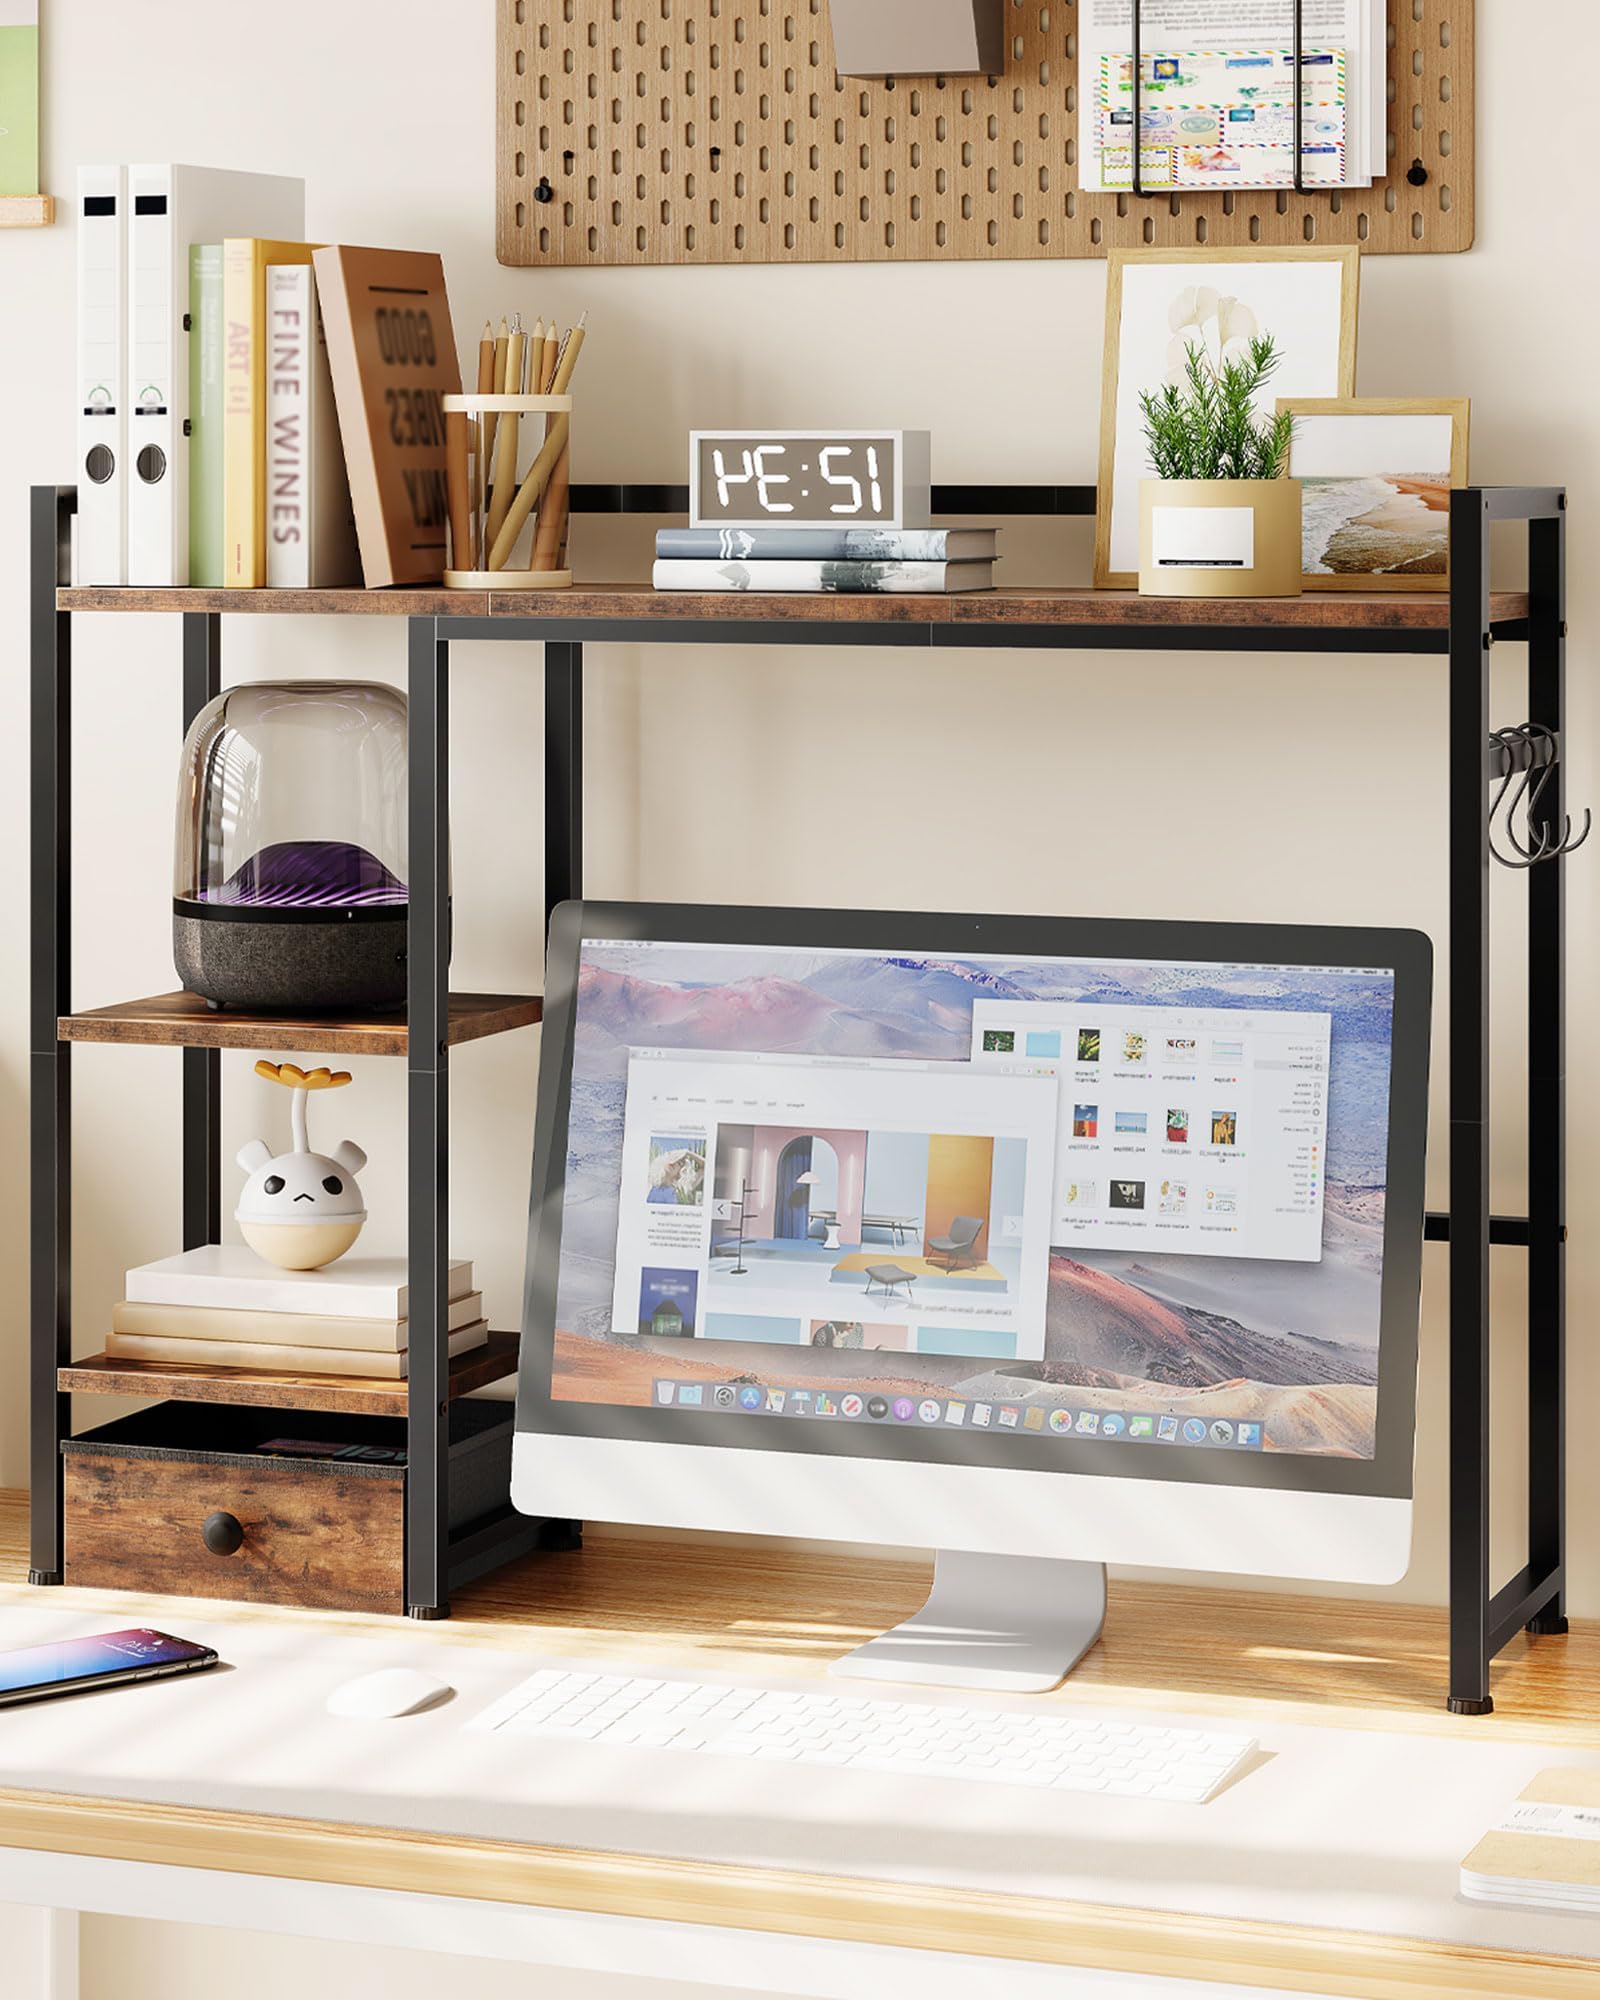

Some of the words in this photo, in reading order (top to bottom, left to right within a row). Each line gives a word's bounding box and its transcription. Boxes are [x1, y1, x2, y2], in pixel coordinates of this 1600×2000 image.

[227, 321, 250, 375] ART
[273, 311, 300, 396] FINE
[273, 414, 300, 545] WINES
